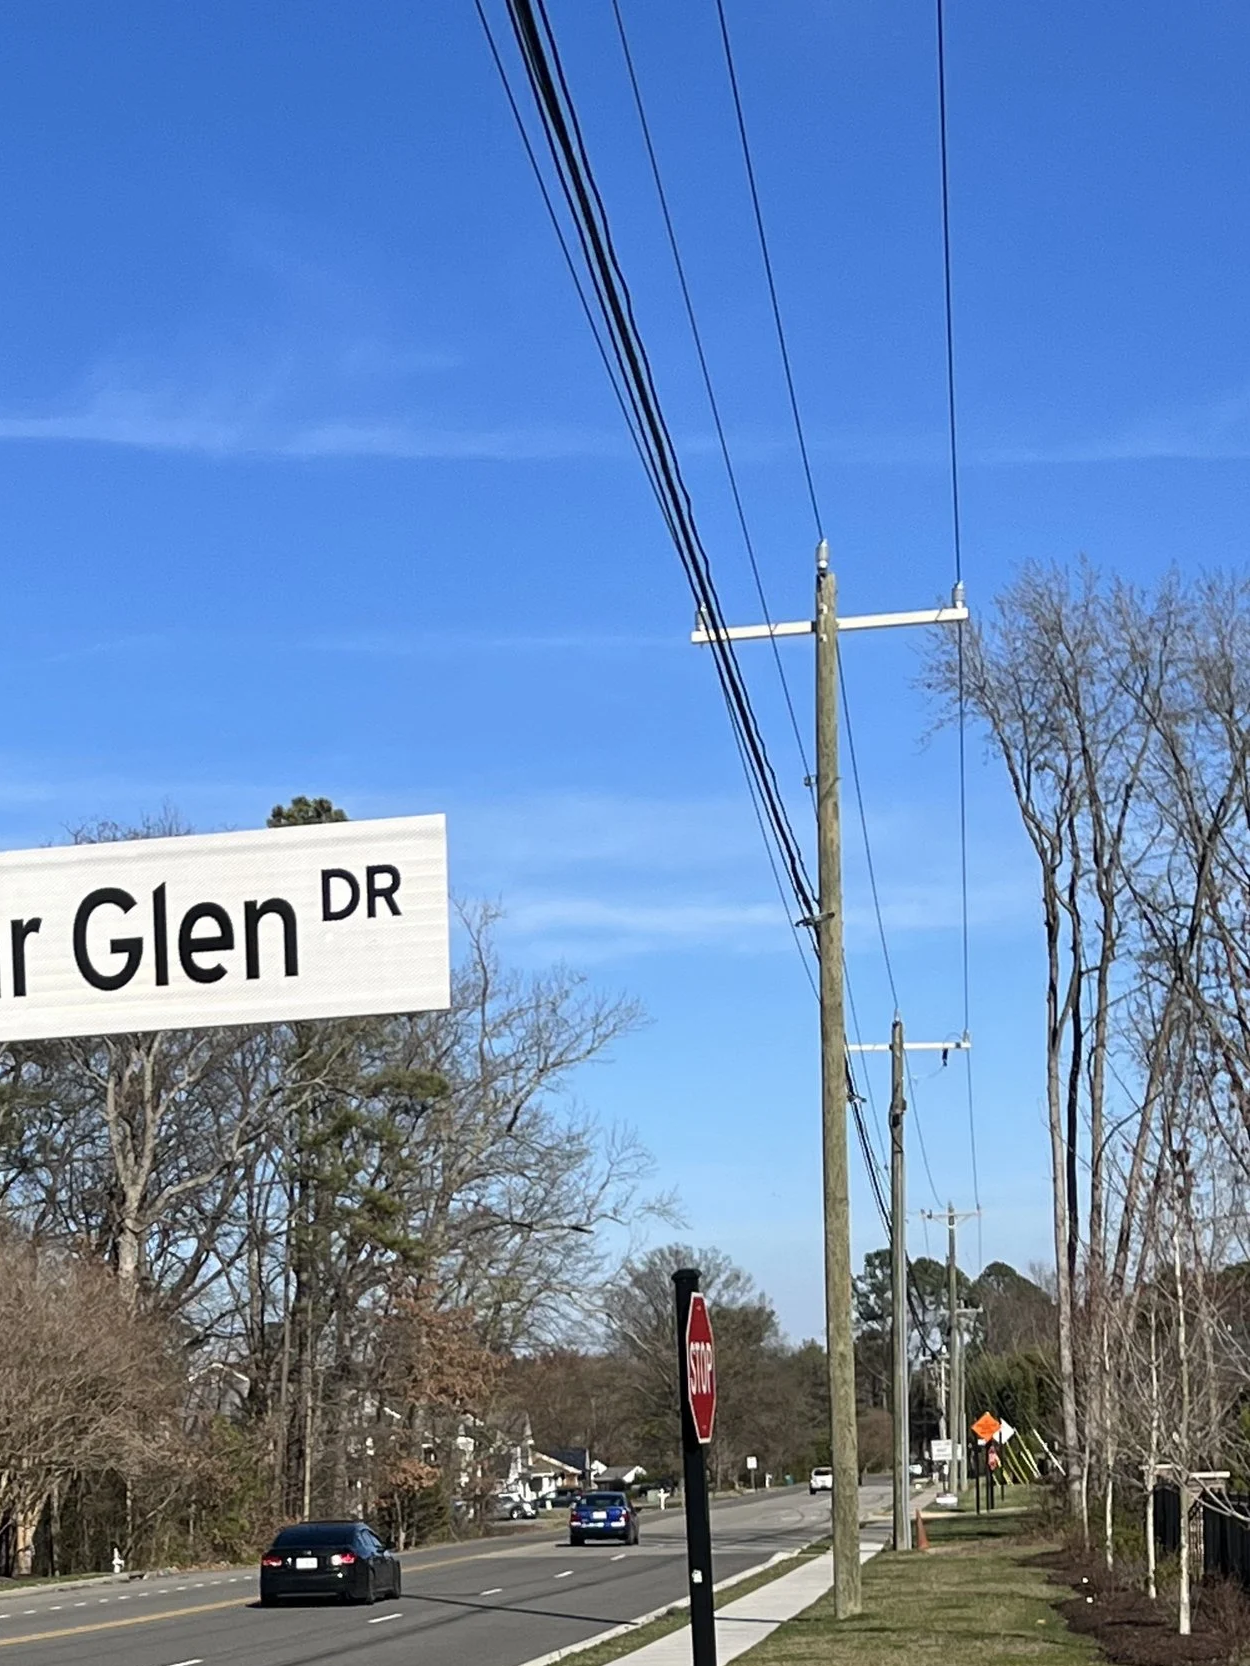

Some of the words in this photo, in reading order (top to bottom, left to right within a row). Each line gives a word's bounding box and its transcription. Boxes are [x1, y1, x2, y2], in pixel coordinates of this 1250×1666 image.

[73, 882, 299, 992] Glen
[321, 864, 402, 922] DR
[690, 1341, 713, 1395] STOP
